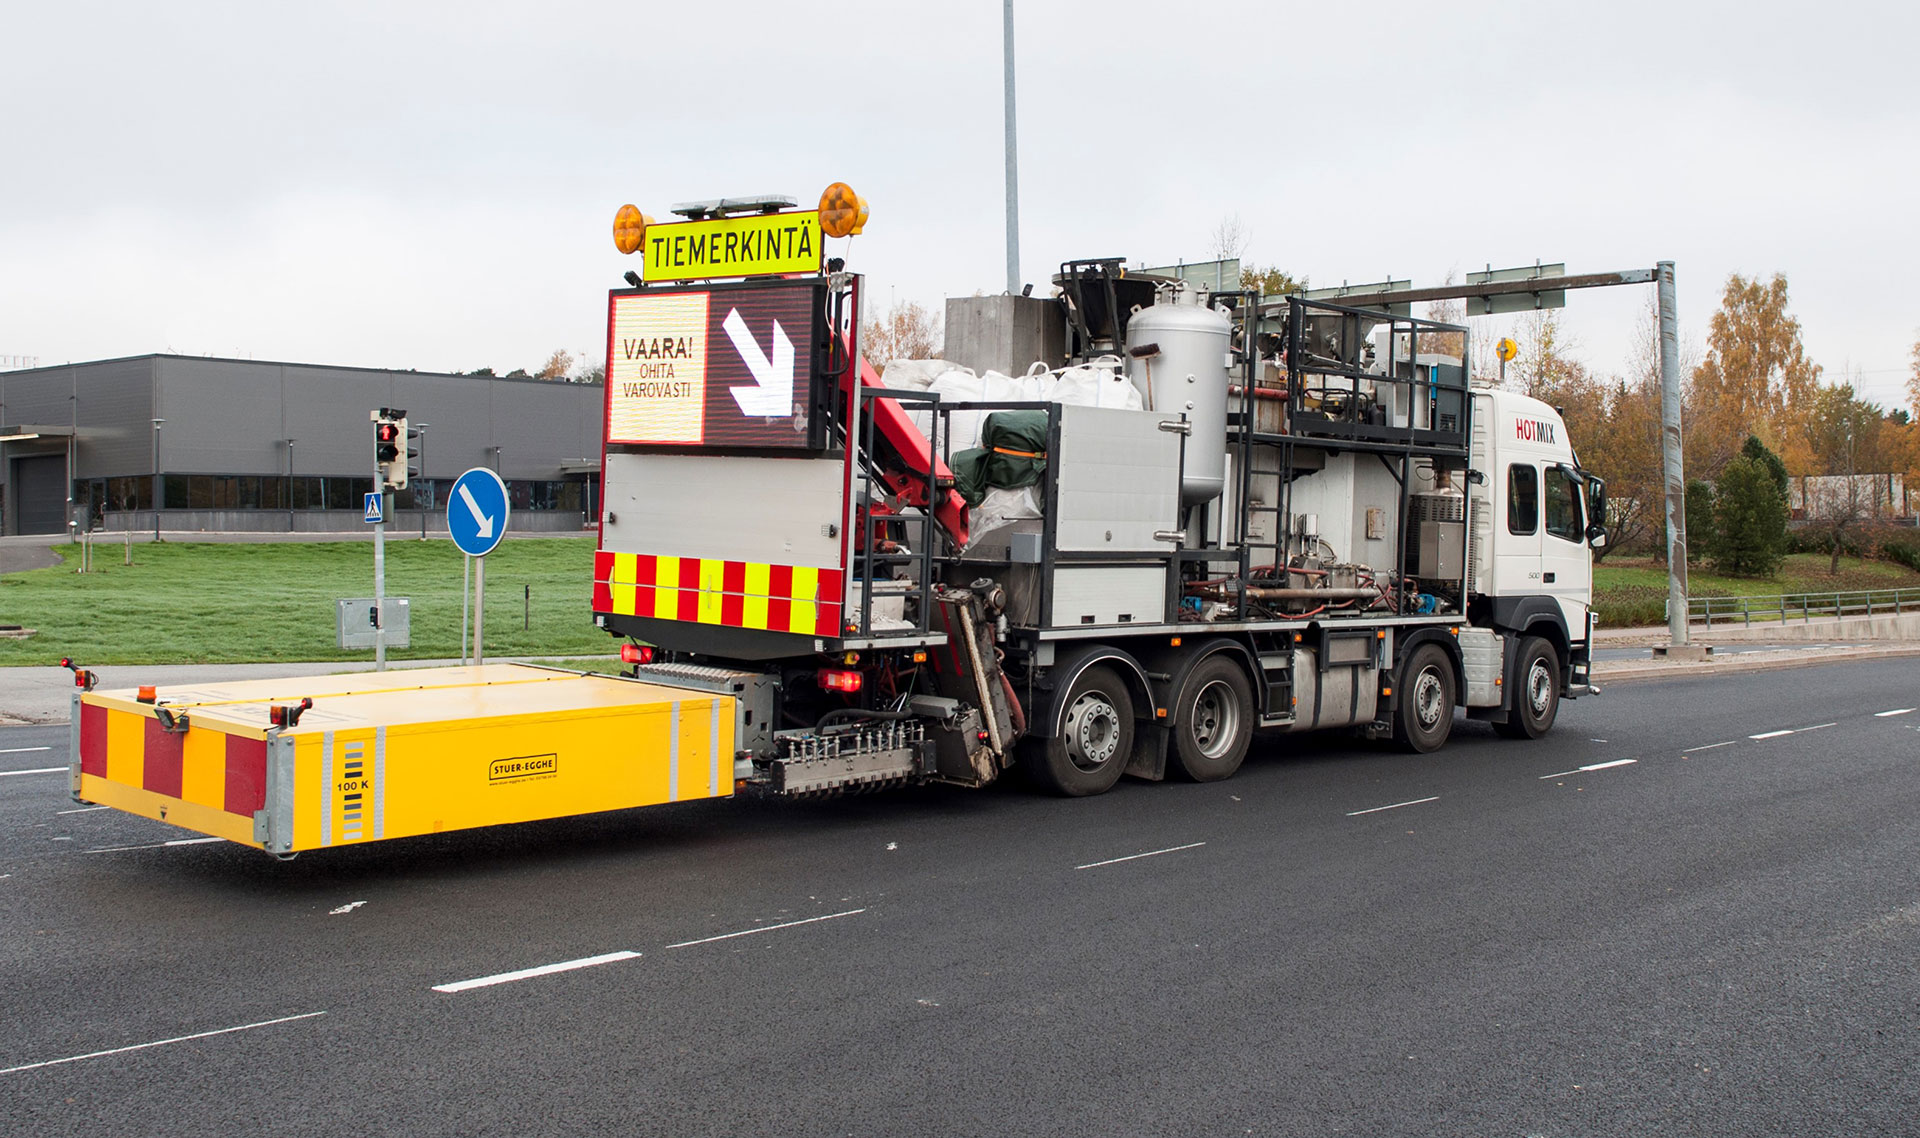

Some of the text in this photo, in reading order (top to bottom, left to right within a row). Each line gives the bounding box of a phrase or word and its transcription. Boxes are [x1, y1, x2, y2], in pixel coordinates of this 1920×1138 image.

[652, 219, 812, 267] TIEMERKINTÄ
[624, 337, 692, 359] VAARA!
[640, 363, 675, 378] OHITA
[623, 382, 691, 398] VAROVASTI
[1516, 418, 1555, 444] HOTMIX
[494, 760, 552, 774] STUER-EGGHE
[337, 780, 368, 791] 100 K
